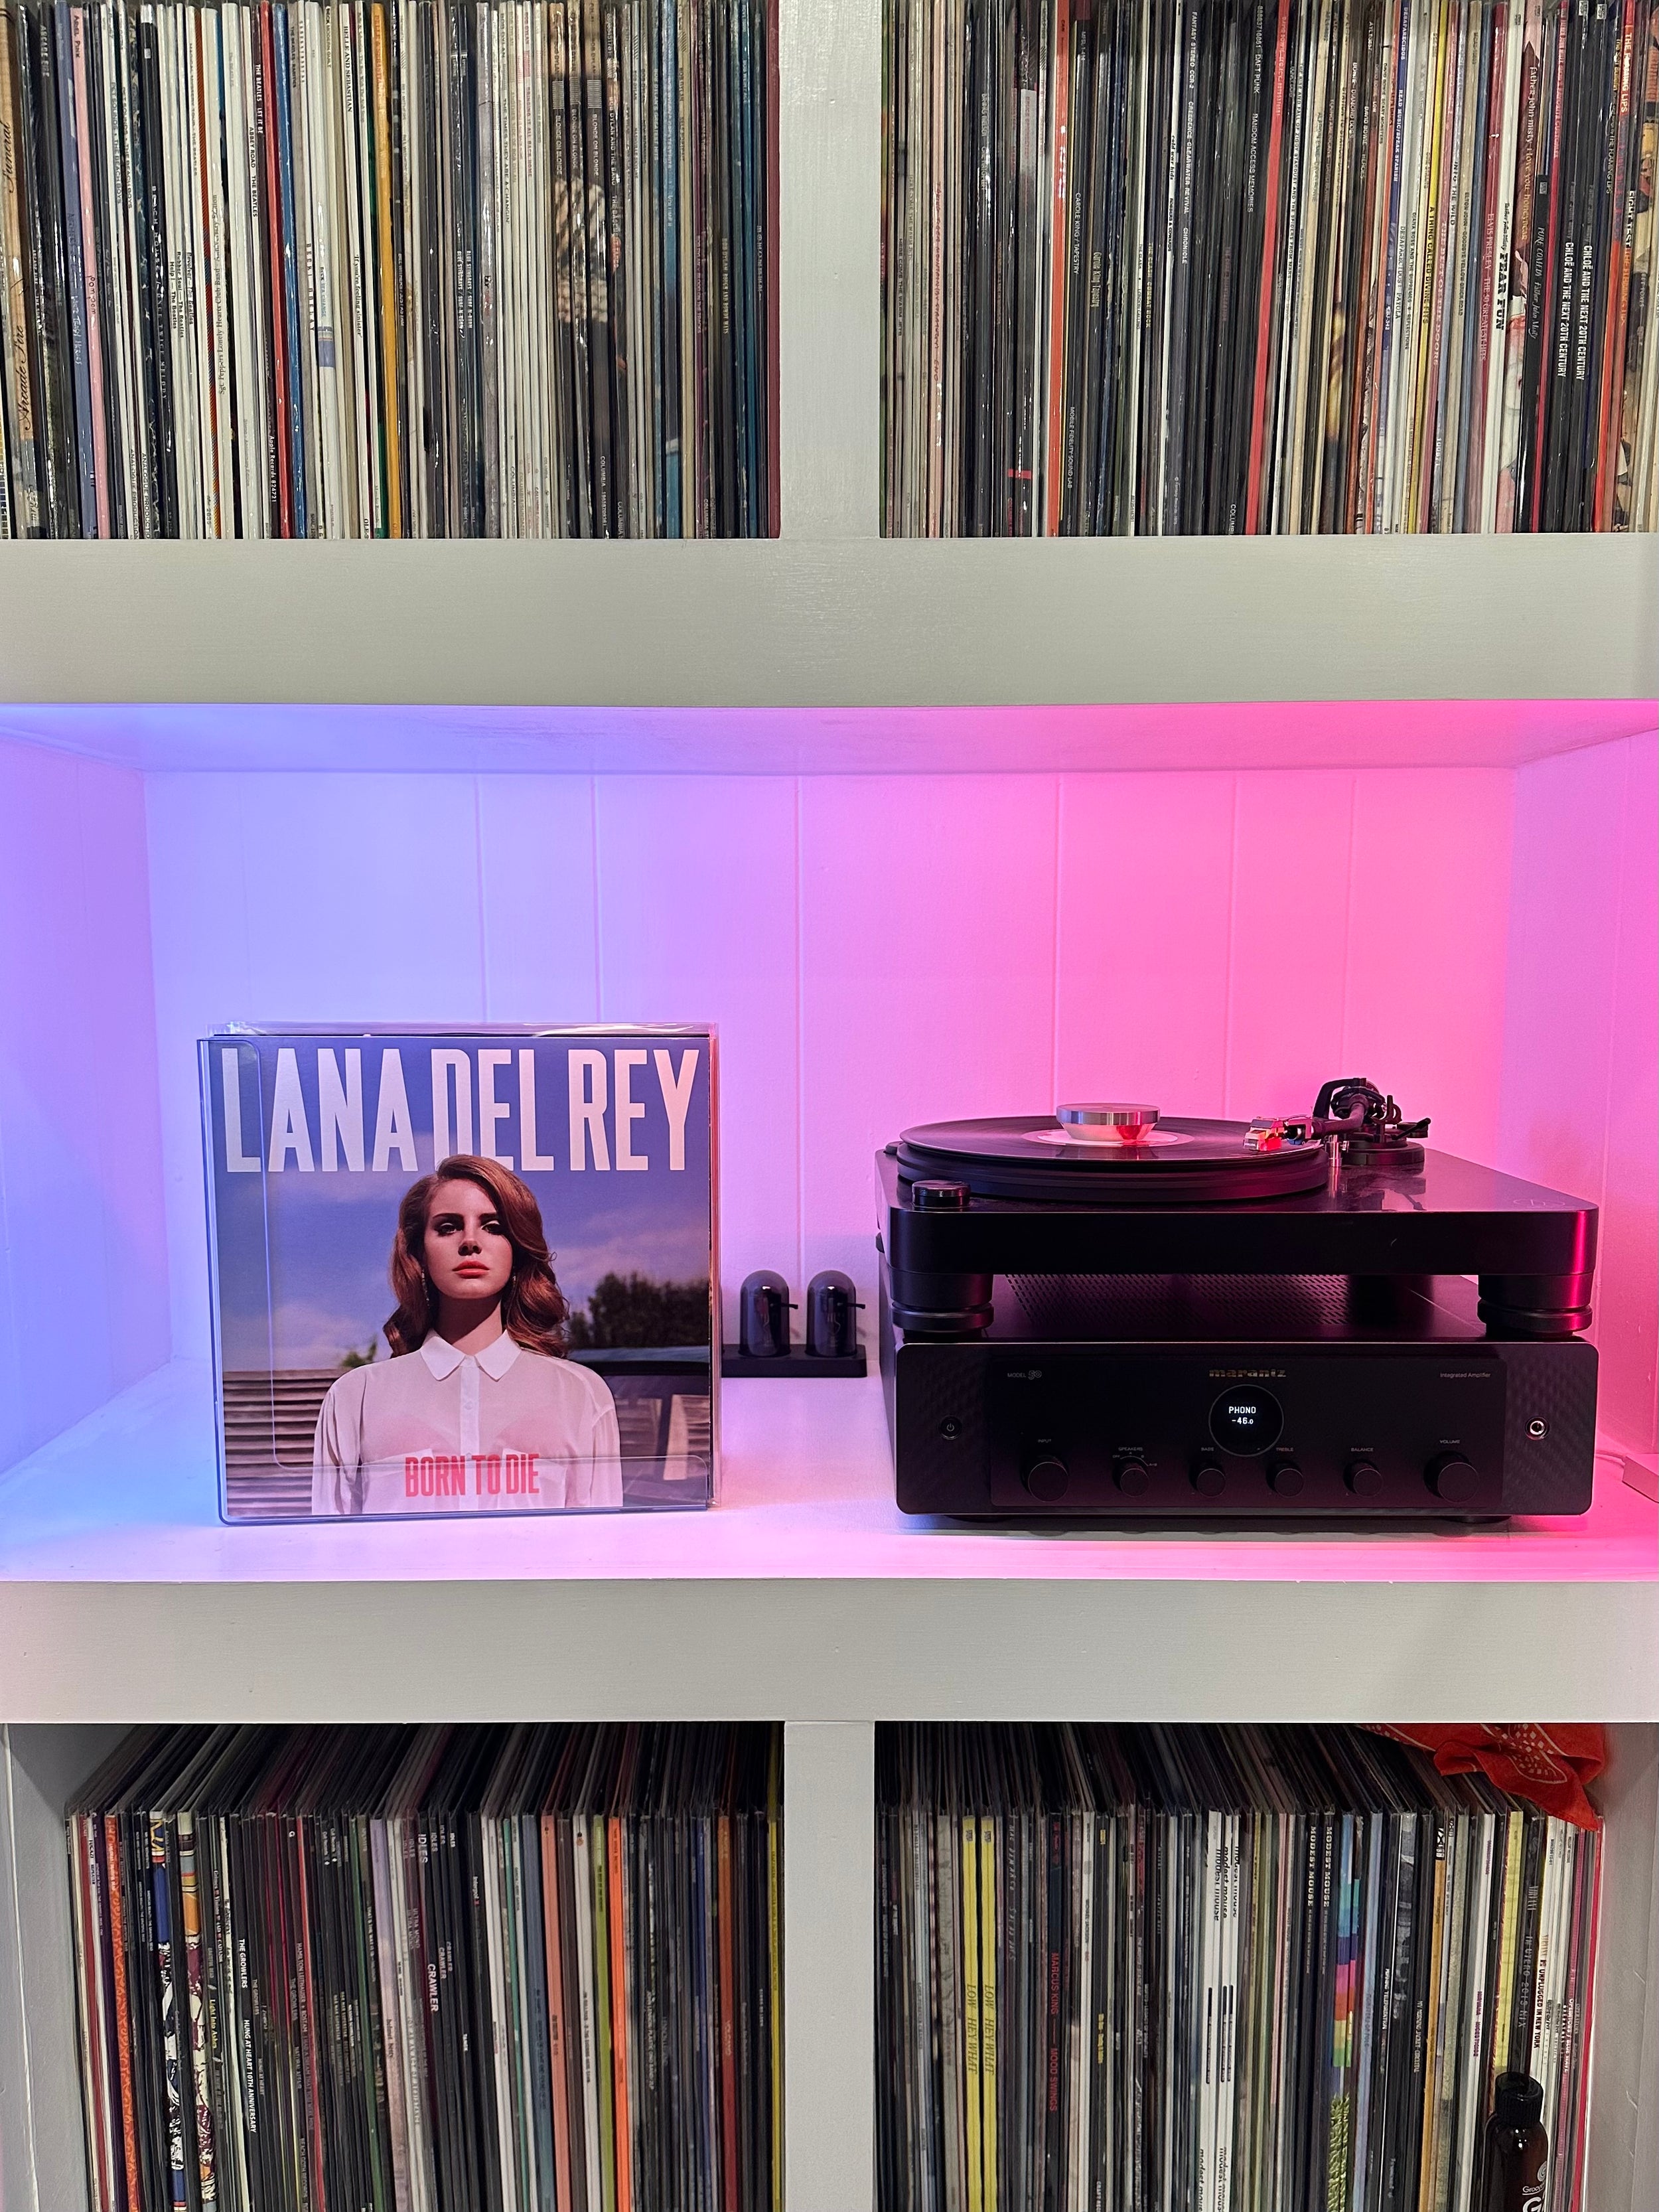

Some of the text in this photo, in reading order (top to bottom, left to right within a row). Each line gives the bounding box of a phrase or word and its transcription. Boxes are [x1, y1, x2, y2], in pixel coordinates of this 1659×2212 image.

[39, 25, 50, 57] ARCADE
[1624, 33, 1632, 50] THE
[1526, 67, 1538, 143] father john misty
[1621, 94, 1629, 113] LIPS
[593, 140, 599, 149] ON
[1247, 175, 1256, 212] MEMORIES
[1426, 215, 1435, 240] THING
[1484, 214, 1494, 270] ELVIS PRESLEY
[1495, 253, 1507, 330] FEAR FUN
[1532, 282, 1542, 301] Father
[1422, 306, 1431, 324] FITS
[1530, 302, 1541, 319] John
[1556, 242, 1576, 377] CHLOË AND THE NEXT 20TH CENTURY
[1575, 245, 1595, 380] CHLOË AND THE NEXT 20TH CENTURY
[1529, 321, 1540, 339] Misty
[221, 1049, 699, 1172] LANA DEL REY
[1209, 1369, 1286, 1378] marantz
[405, 1453, 540, 1497] BORN TO DIE
[417, 1834, 429, 1863] IDLES
[1307, 1826, 1317, 1907] MODEST MOUSE
[1323, 1826, 1332, 1907] MODEST MOUSE
[238, 1939, 246, 1951] THE
[1524, 1937, 1534, 1946] IN
[239, 1953, 249, 1988] GROWLERS
[1522, 1948, 1532, 1976] UTERO
[427, 1964, 439, 2012] CRAWLER
[1536, 1969, 1545, 2007] UNPLUGGED
[244, 2020, 252, 2039] HUNG
[968, 1984, 977, 2074] LOW HEY WHAT
[985, 1984, 994, 2075] LOW HEY WHAT
[1049, 1953, 1059, 2111] MARCUS KING MOOD SWINGS
[1517, 2010, 1528, 2028] MIX
[245, 2049, 253, 2070] HEART
[246, 2071, 255, 2087] 10TH
[247, 2088, 257, 2133] ANNIVERSARY
